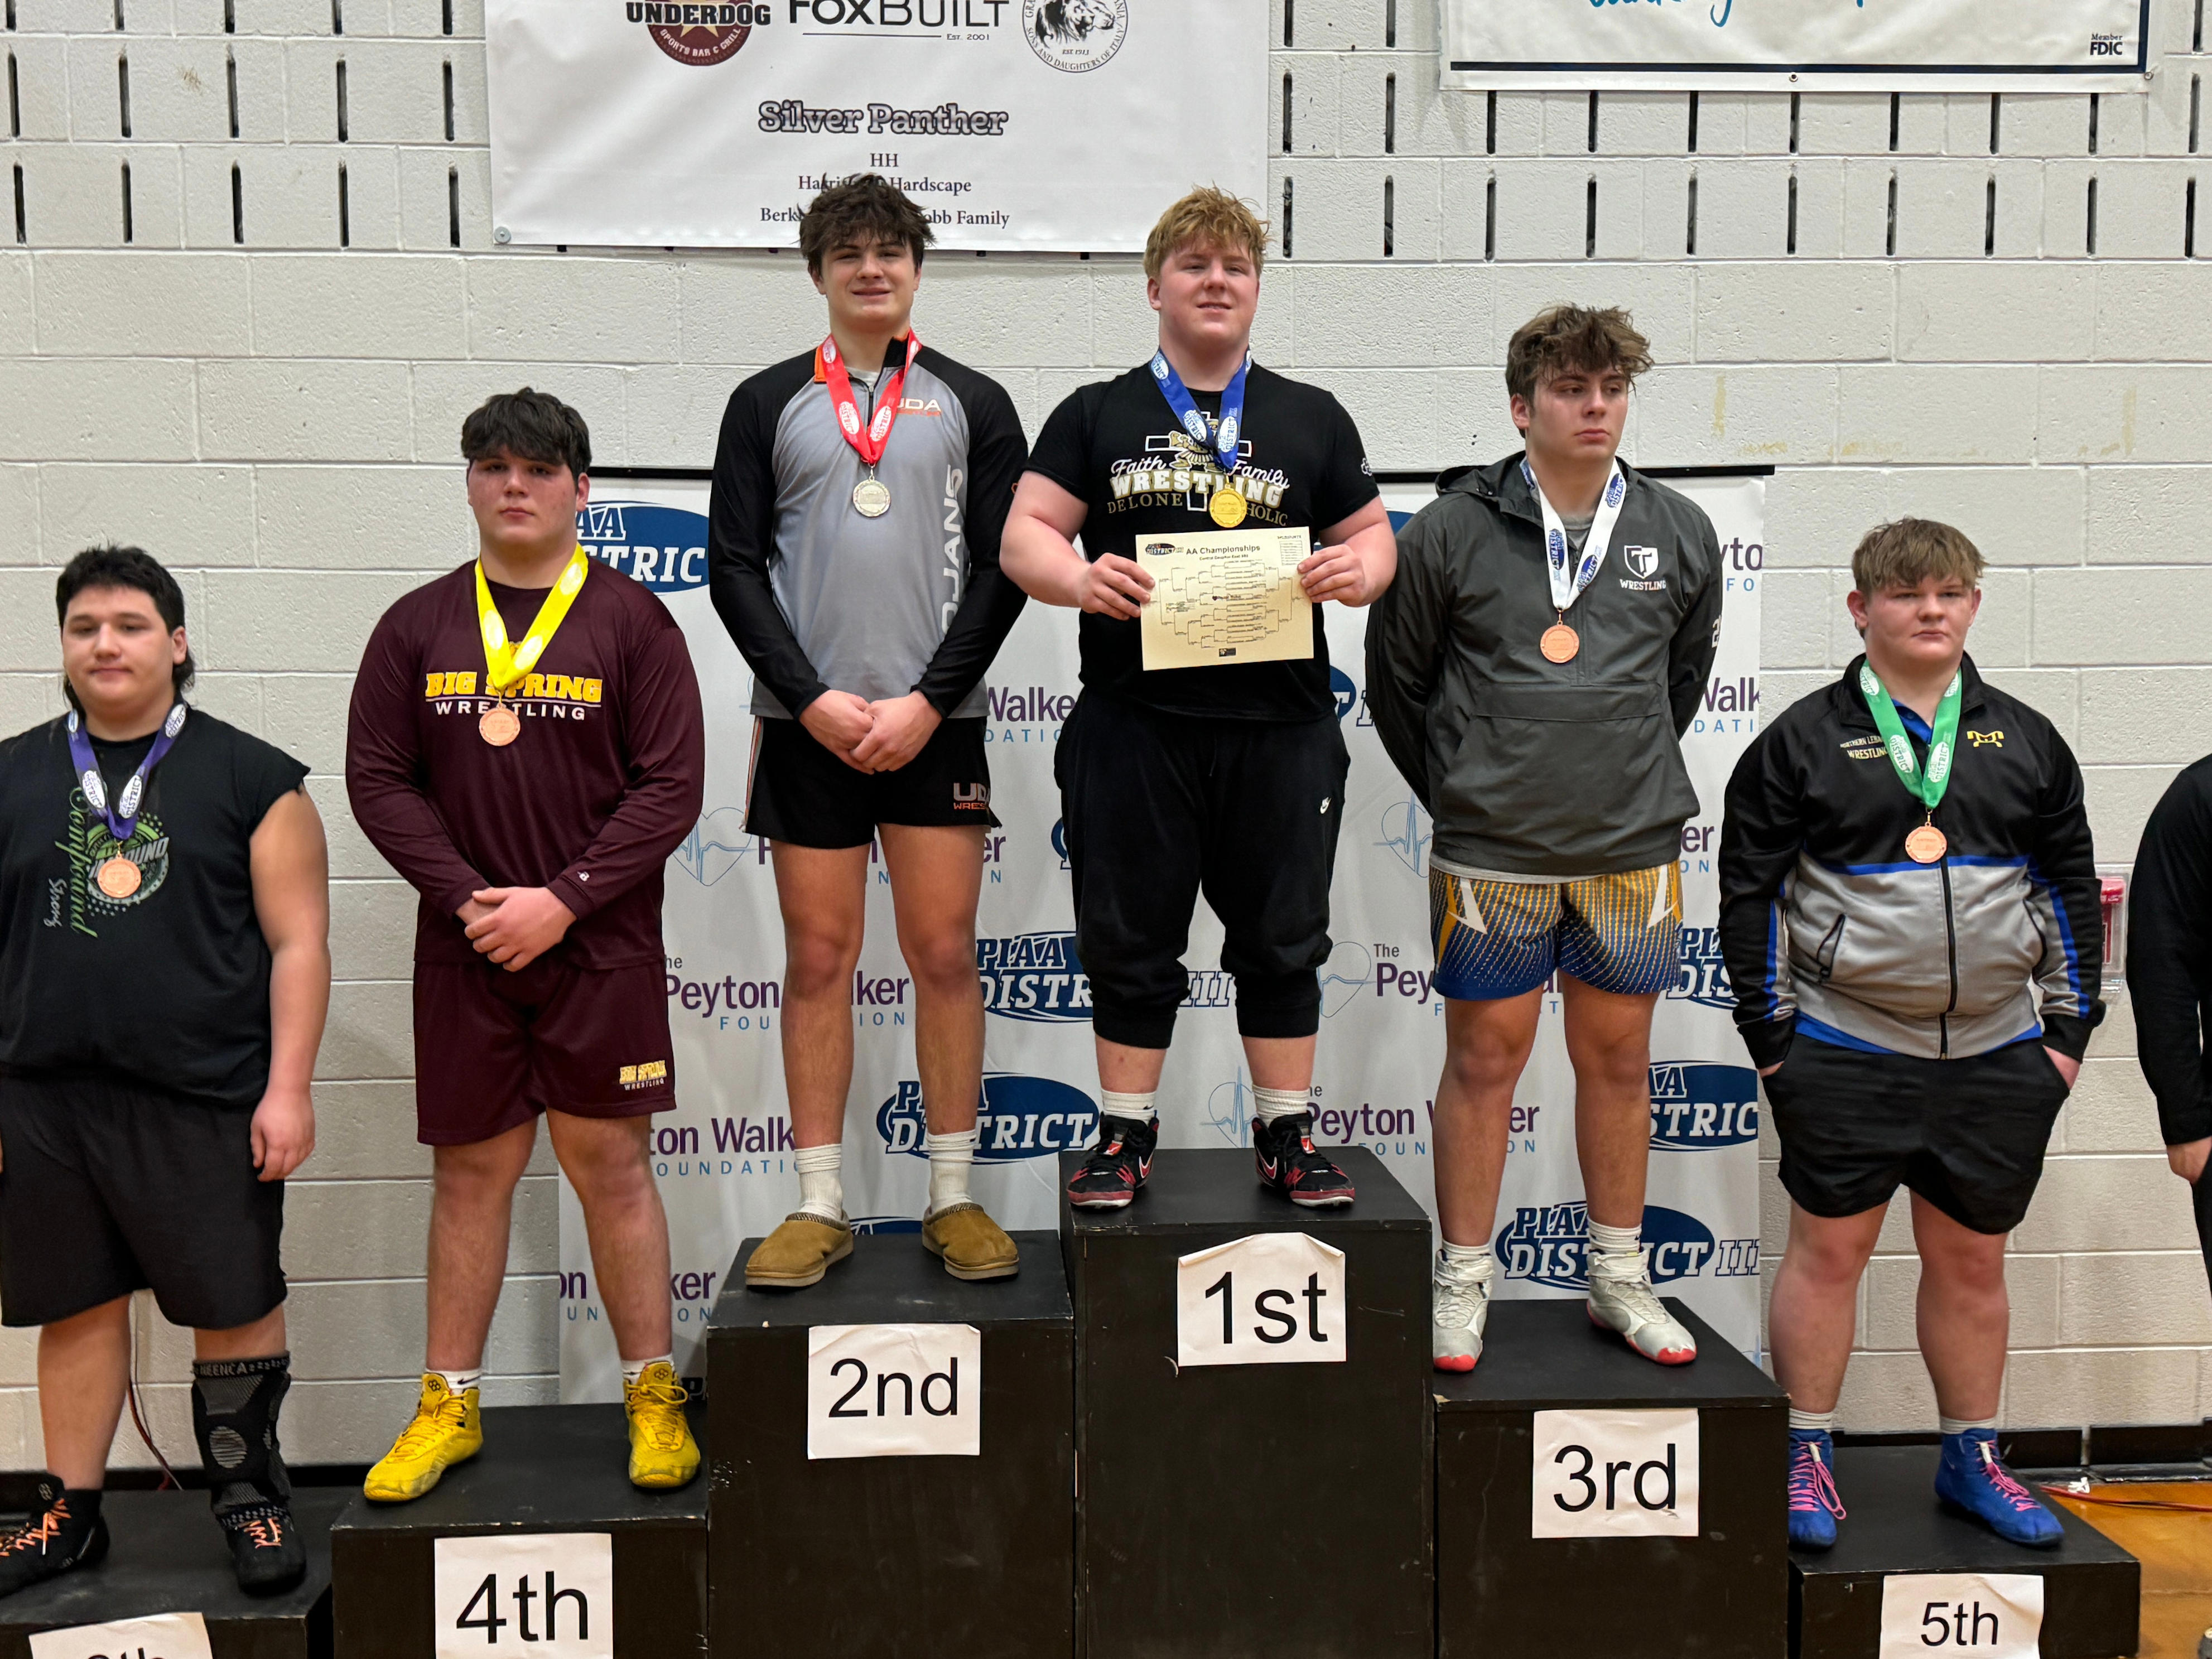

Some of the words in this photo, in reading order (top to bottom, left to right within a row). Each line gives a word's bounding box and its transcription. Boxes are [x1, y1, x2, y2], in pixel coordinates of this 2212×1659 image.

[626, 2, 771, 26] UNDERDOG
[789, 0, 1010, 27] FOXBUILT
[660, 28, 690, 55] SPORTS
[692, 48, 711, 56] BAR
[720, 28, 741, 50] GRILL
[1038, 49, 1053, 63] AND
[1054, 57, 1101, 70] DAUGHTERS
[1101, 50, 1111, 61] OF
[1110, 29, 1125, 51] ITALY
[2090, 41, 2123, 55] FDIC
[758, 99, 864, 134] Silver
[868, 103, 1009, 136] Panther
[870, 153, 899, 167] HH
[889, 177, 972, 196] Hardscape
[924, 210, 952, 224] obb
[957, 210, 1010, 229] Family
[1109, 470, 1284, 509] WRESTLING
[1111, 455, 1167, 478] Faith
[1228, 460, 1290, 490] Family
[1107, 493, 1183, 514] DELONE
[1246, 503, 1288, 527] HOLIC
[941, 464, 963, 635] OJANS
[1199, 544, 1261, 555] Championships
[1619, 578, 1666, 591] WRESTLING
[425, 672, 478, 697] BIG
[435, 701, 585, 720] WRETLING
[988, 687, 1076, 722] Walke
[1847, 747, 1888, 759] WRESTLIN
[666, 956, 683, 968] he
[975, 938, 1067, 970] PIAA
[1373, 944, 1399, 958] The
[666, 975, 779, 1019] Peyton
[1376, 963, 1434, 1004] Pey
[712, 1117, 795, 1155] Walk
[886, 1113, 1093, 1154] DTRICT
[1204, 1271, 1328, 1344] 1st
[828, 1356, 959, 1417] 2nd
[1553, 1443, 1677, 1512] 3rd
[456, 1570, 589, 1644] 4th
[1921, 1600, 1999, 1647] 5th
